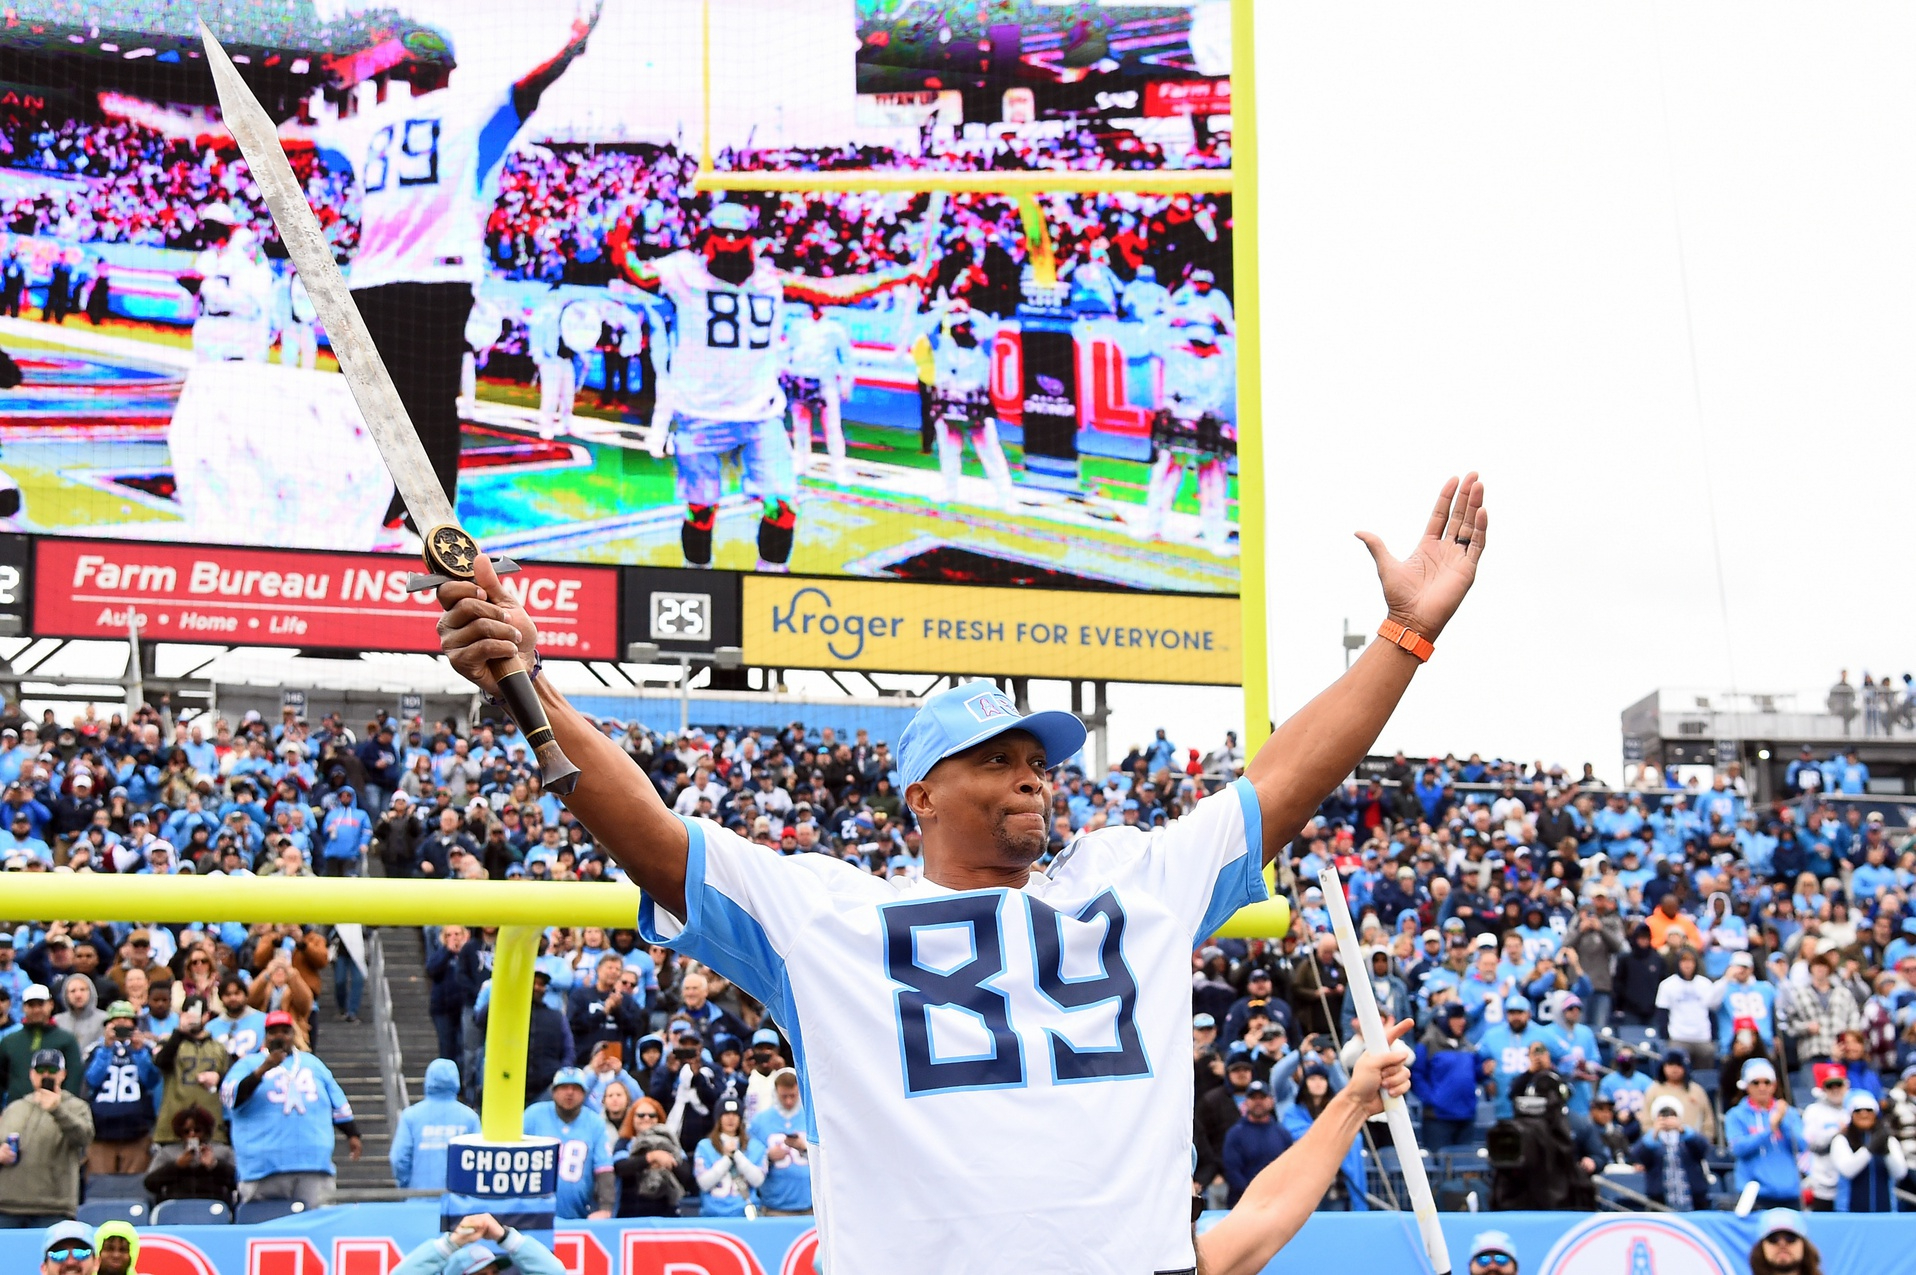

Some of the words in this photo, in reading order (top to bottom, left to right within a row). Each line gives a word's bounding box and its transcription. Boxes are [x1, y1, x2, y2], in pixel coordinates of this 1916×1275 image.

[364, 118, 441, 194] 89
[706, 289, 775, 350] 89
[73, 555, 177, 592] Farm
[189, 561, 330, 600] Bureau
[340, 568, 582, 612] INSNCE
[179, 611, 239, 633] Home
[268, 615, 308, 636] Life
[658, 597, 704, 635] 25
[772, 587, 905, 661] Kroger
[923, 618, 1004, 642] FRESH
[1016, 622, 1068, 645] FOR
[1080, 625, 1213, 651] EVERYONE
[876, 886, 1154, 1099] 89
[264, 1064, 319, 1104] 34
[461, 1149, 554, 1173] CHOOSE
[475, 1171, 542, 1194] LOVE
[556, 1139, 589, 1183] 8
